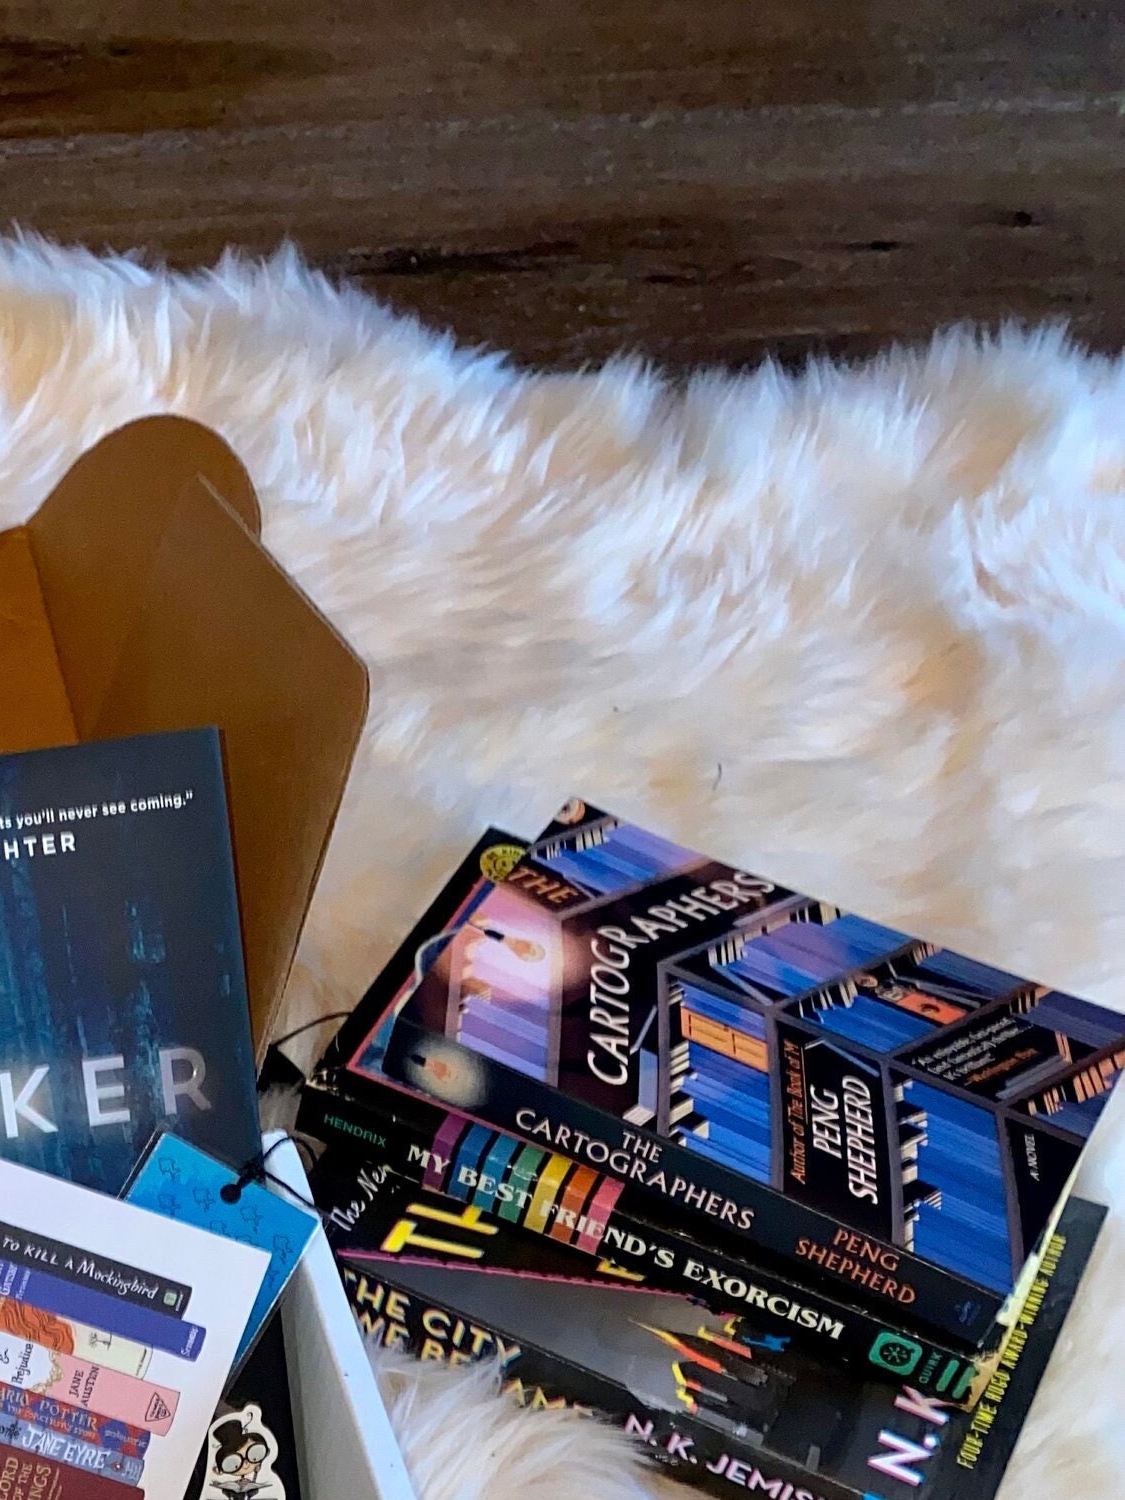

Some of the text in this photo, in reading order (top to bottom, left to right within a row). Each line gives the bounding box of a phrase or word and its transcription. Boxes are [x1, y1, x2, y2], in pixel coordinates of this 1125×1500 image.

[16, 808, 55, 830] you'll
[59, 804, 98, 822] never
[102, 801, 126, 816] see
[507, 865, 579, 904] THE
[587, 872, 775, 1086] CARTOGRAPHERS
[324, 1113, 388, 1148] HENDRIX
[787, 1100, 804, 1120] The
[810, 1084, 842, 1159] PENG
[622, 1131, 663, 1163] THE
[790, 1137, 806, 1185] Author
[842, 1075, 878, 1205] SHEPHERD
[515, 1108, 756, 1230] CARTOGRAPHERS
[330, 1199, 365, 1231] The
[407, 1144, 451, 1176] MY
[457, 1165, 534, 1209] BEST
[539, 1199, 675, 1269] FRIEND'S
[682, 1258, 846, 1339] EXORCISM
[833, 1227, 900, 1273] PENG
[2, 1237, 159, 1300] TO KILL A Mockingbird
[795, 1237, 916, 1305] SHEPHERD
[422, 1308, 523, 1368] CITY
[957, 1234, 1066, 1469] FOUR-TIME HUGO AWARD-WINNING AUTHOR
[11, 1343, 34, 1385] Prejudice
[69, 1369, 84, 1398] JANE
[83, 1365, 100, 1407] AUSTEN
[919, 1351, 943, 1384] QUIRK
[39, 1402, 97, 1429] POTTER
[625, 1412, 657, 1446] N.
[666, 1433, 698, 1464] K.
[22, 1422, 65, 1456] JANE
[63, 1443, 111, 1470] EYRE
[18, 1463, 33, 1488] THE
